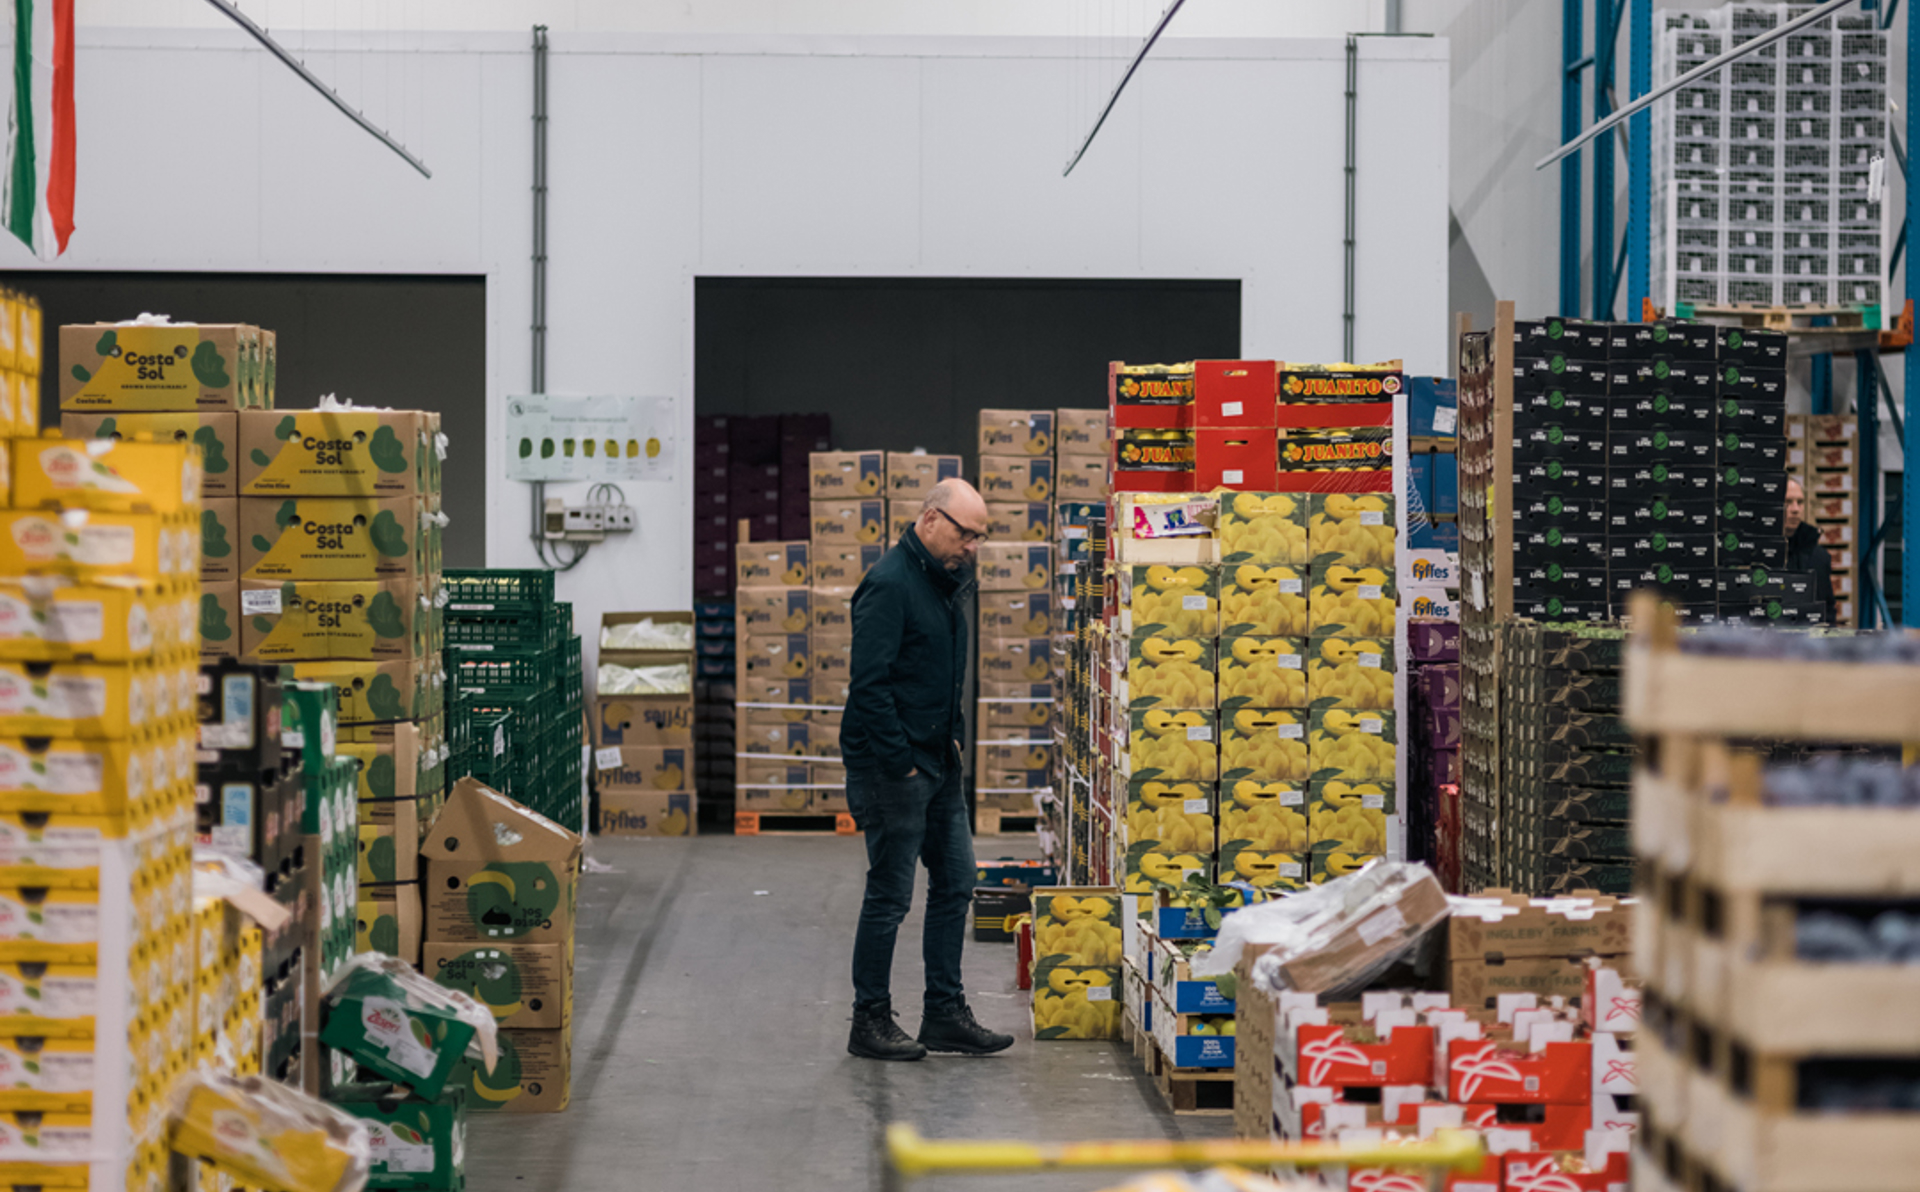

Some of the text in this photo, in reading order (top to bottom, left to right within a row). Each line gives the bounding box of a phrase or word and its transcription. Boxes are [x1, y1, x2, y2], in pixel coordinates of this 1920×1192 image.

[124, 352, 174, 366] Costa
[137, 366, 165, 380] Sol
[1303, 378, 1383, 396] JUANITO
[303, 436, 353, 451] Costa
[316, 452, 343, 465] Sol
[1302, 441, 1381, 462] JUANITO
[304, 521, 353, 535] Costa
[317, 536, 344, 549] Sol
[1413, 563, 1449, 581] Fyffes
[304, 600, 352, 614] Costa
[1413, 602, 1450, 616] Fyffes
[318, 614, 341, 627] Sol
[602, 810, 647, 832] Fyffes
[522, 908, 542, 918] Sol
[514, 919, 552, 929] Costa
[1486, 926, 1599, 940] INGLEBY FARMS
[437, 958, 475, 969] Costa
[447, 969, 467, 980] Sol
[1489, 976, 1582, 988] INGLEBY FAR
